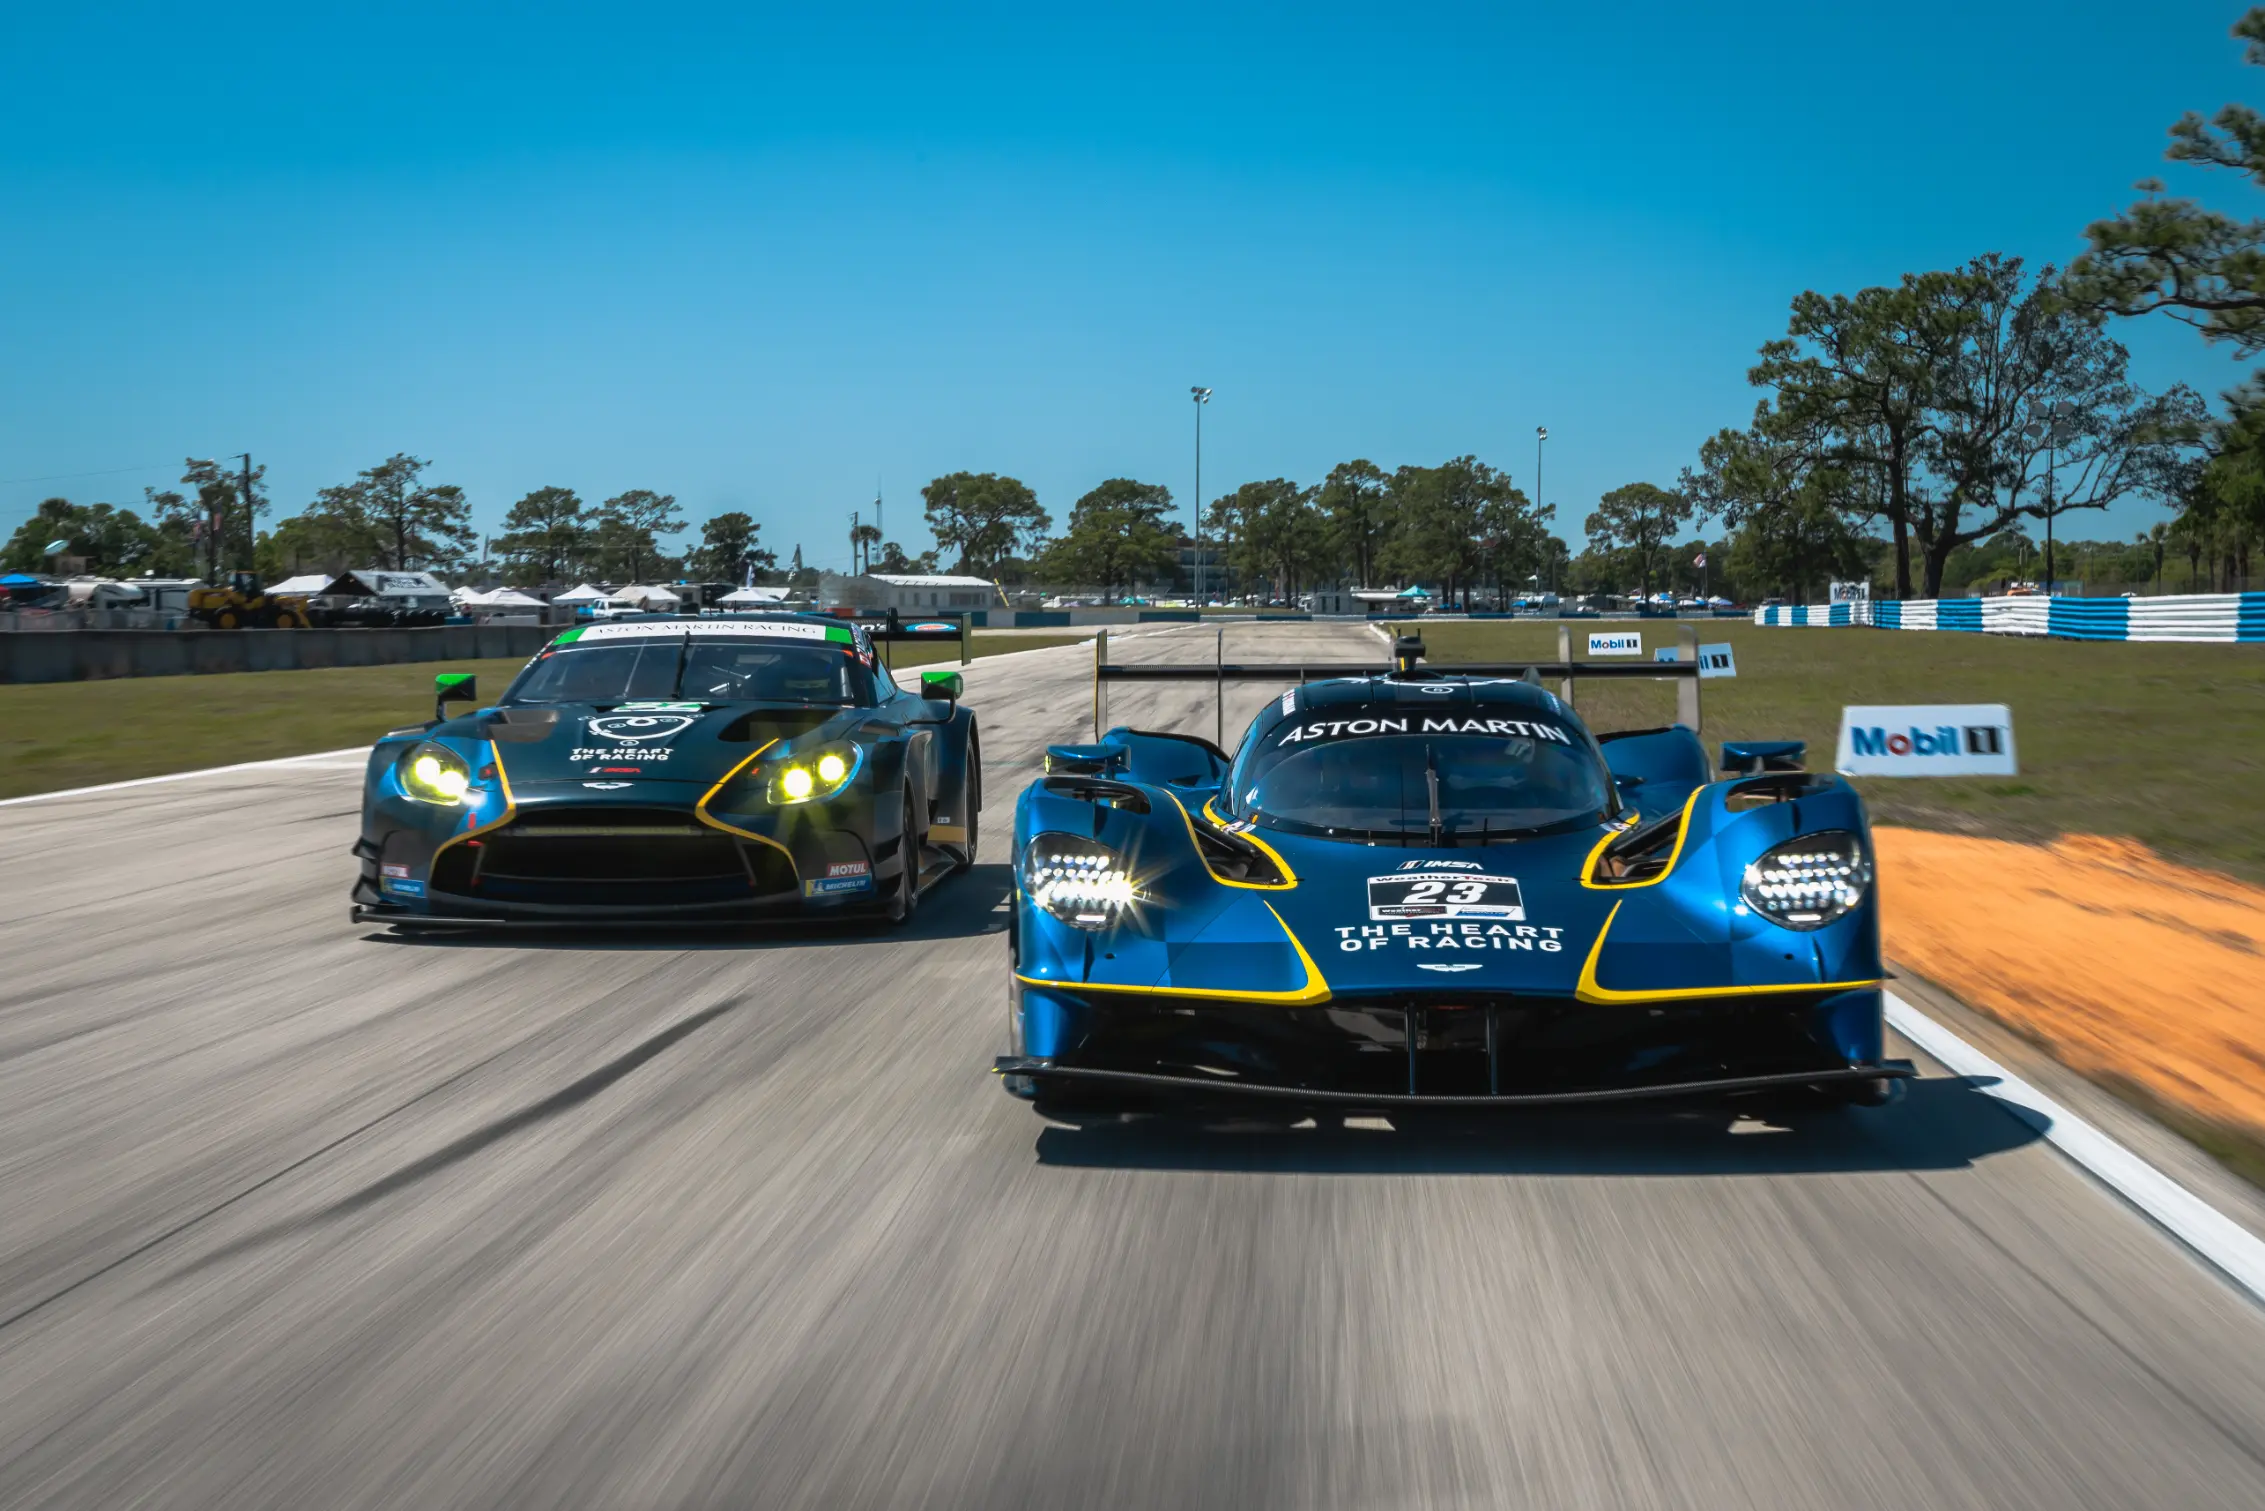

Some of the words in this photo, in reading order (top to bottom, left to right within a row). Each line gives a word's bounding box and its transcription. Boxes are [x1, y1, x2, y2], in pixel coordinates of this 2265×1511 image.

[1590, 639, 1625, 649] Mobil
[1626, 639, 1638, 648] 1
[1278, 718, 1408, 747] ASTON
[1422, 718, 1572, 745] MARTIN
[1851, 725, 1961, 756] Mobil
[1962, 725, 2005, 756] 1
[829, 863, 867, 877] MOTUL
[1424, 860, 1484, 871] IMSA
[825, 880, 867, 890] MICHELIN
[1375, 874, 1511, 883] WeatherTech
[1402, 881, 1488, 904] 23
[1334, 924, 1412, 938] THE
[1430, 923, 1565, 939] HEART
[1340, 937, 1389, 951] OF
[1408, 936, 1564, 952] RACING
